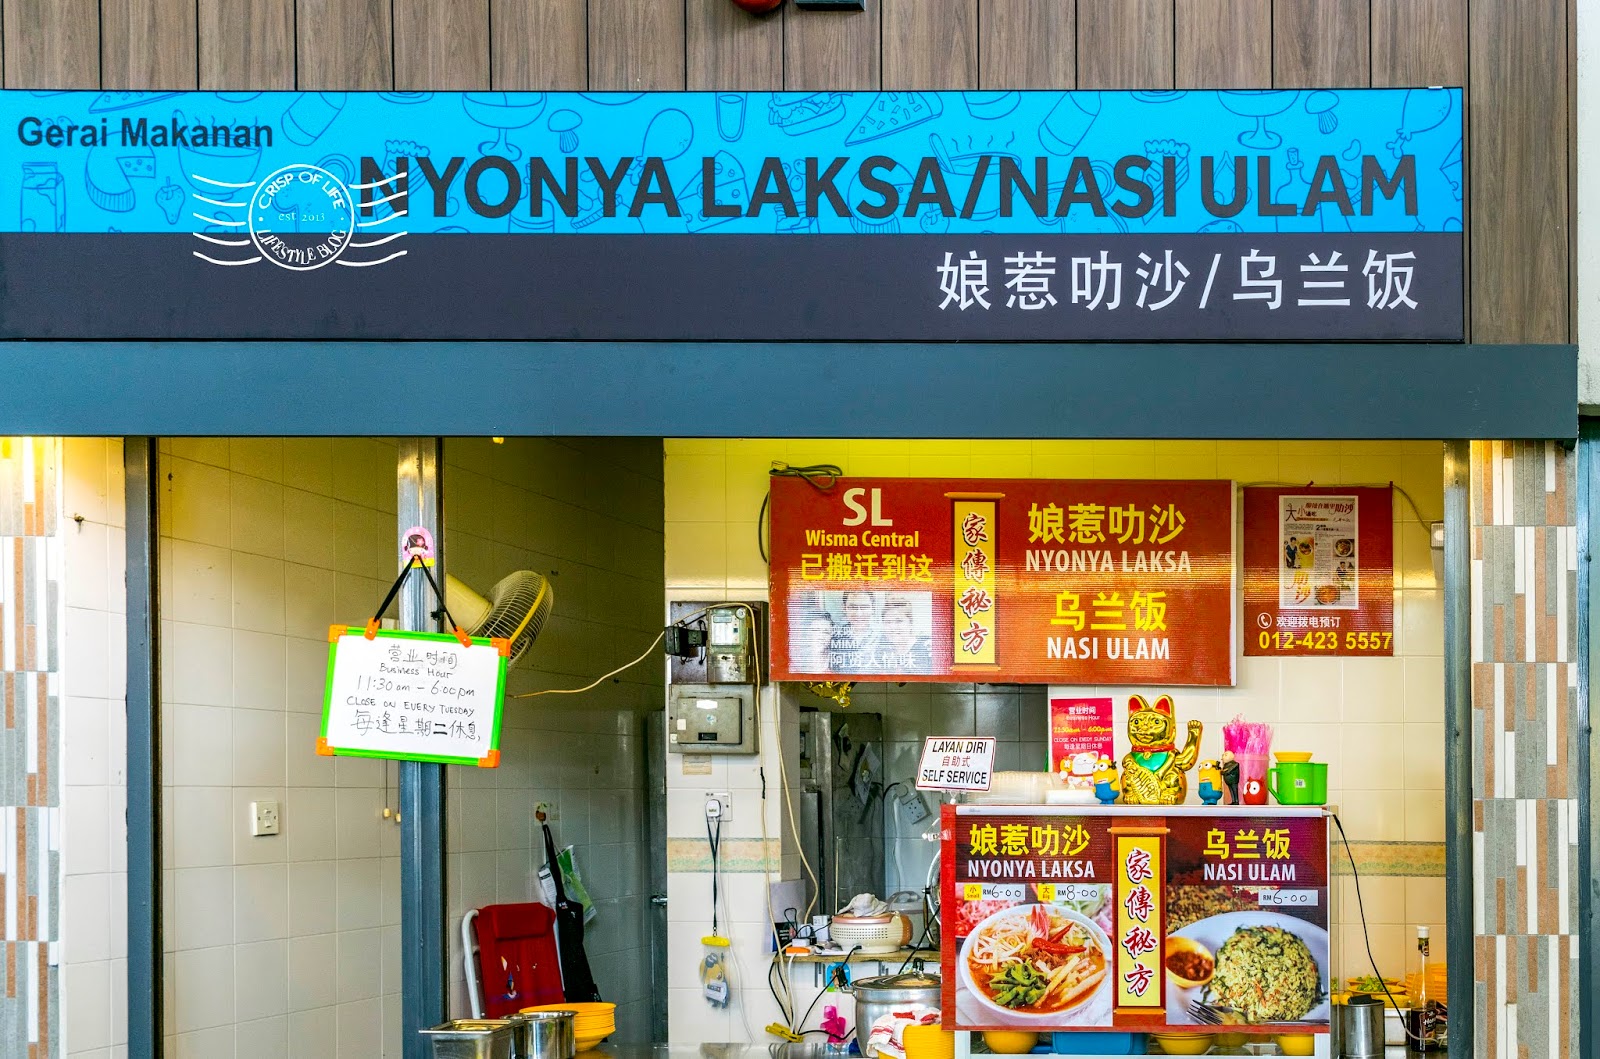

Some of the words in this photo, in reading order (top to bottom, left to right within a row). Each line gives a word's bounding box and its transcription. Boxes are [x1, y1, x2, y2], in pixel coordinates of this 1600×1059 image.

[18, 117, 107, 147] Gerai
[121, 117, 273, 147] Makanan
[361, 156, 680, 218] NYONYA
[702, 155, 1175, 219] LAKSA/NASI
[1201, 155, 1419, 218] ULAM
[936, 249, 1419, 311] 娘惹叻沙/乌兰饭
[842, 487, 893, 527] SL
[1027, 502, 1186, 545] 娘惹叻沙
[805, 529, 858, 547] Wisma
[861, 530, 919, 548] Central
[801, 552, 934, 582] 已搬迁到这
[1025, 549, 1114, 573] NYONYA
[1122, 550, 1192, 574] LAKSA
[1050, 590, 1168, 632] 乌兰饭
[1047, 637, 1098, 659] NASI
[1106, 637, 1170, 660] ULAM
[1258, 631, 1338, 650] 012-423
[1345, 632, 1393, 650] 5557
[379, 663, 420, 676] Business
[427, 667, 453, 678] Hour
[346, 696, 376, 707] CLOSE
[404, 702, 435, 713] EVERY
[439, 705, 475, 717] TUESDAY
[350, 709, 481, 741] 每逢星期二休息
[932, 741, 963, 753] LAYAN
[966, 741, 987, 753] DIRI
[942, 755, 971, 767] 自助式
[922, 769, 945, 782] SELF
[946, 770, 987, 784] SERVICE
[968, 823, 1091, 857] 娘惹叻沙
[1203, 828, 1292, 860] 乌兰饭
[967, 859, 1036, 878] NYONYA
[1041, 860, 1095, 878] LAKSA
[1203, 863, 1242, 881] NASI
[1248, 863, 1296, 881] ULAM
[1043, 886, 1050, 894] 大
[1123, 848, 1158, 998] 家傳秘方
